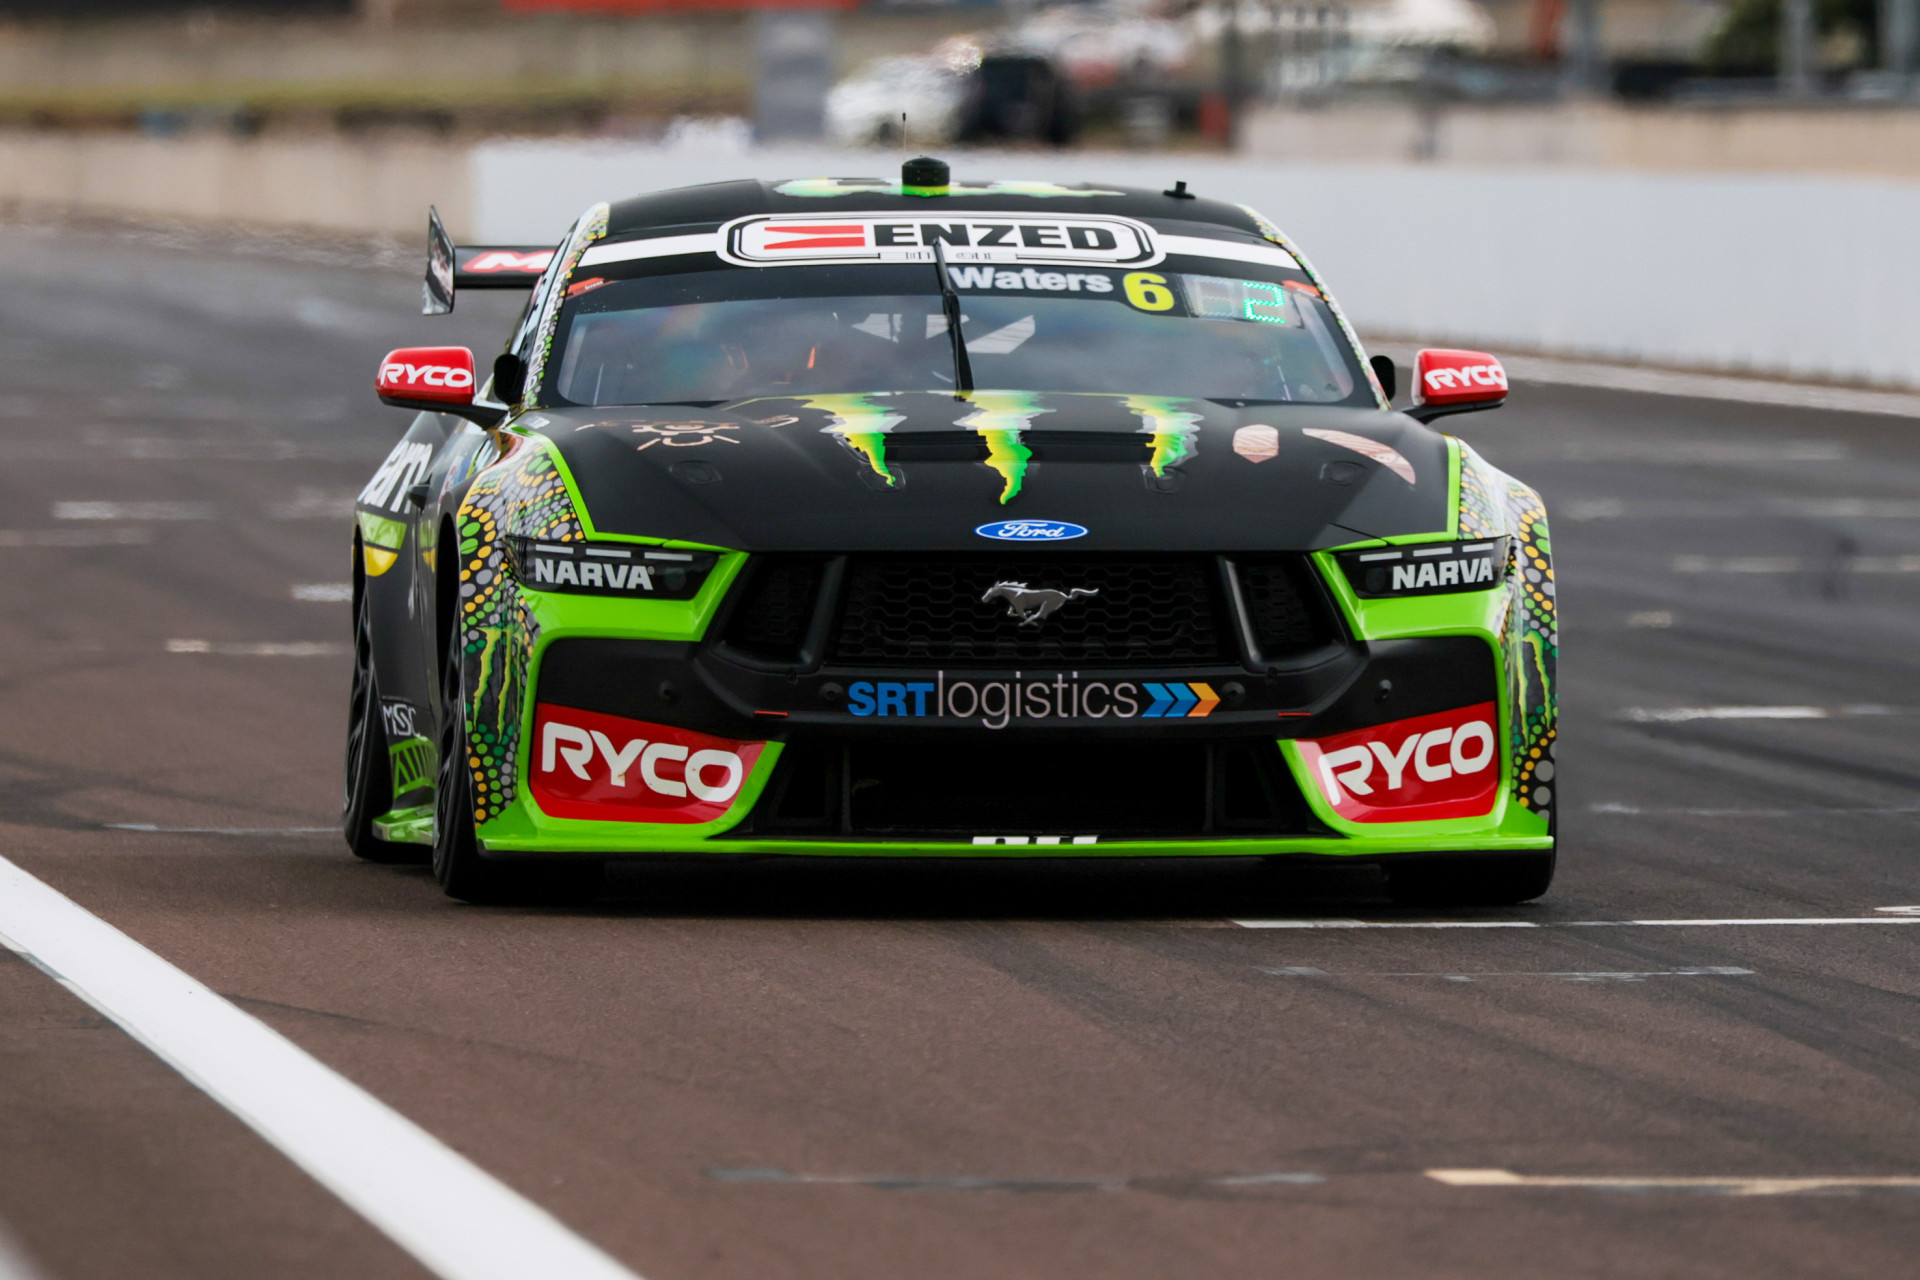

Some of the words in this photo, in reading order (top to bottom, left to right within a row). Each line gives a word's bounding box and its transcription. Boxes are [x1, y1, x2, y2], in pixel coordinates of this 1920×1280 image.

[874, 223, 1118, 250] ENZED
[947, 266, 1114, 293] Waters
[1123, 272, 1175, 311] 6
[1242, 280, 1286, 324] 2
[380, 363, 474, 388] RYCO
[1424, 364, 1508, 390] RYCO
[998, 522, 1065, 538] Ford
[535, 558, 654, 591] NARVA
[1392, 557, 1494, 591] NARVA
[542, 721, 744, 803] RYCO
[1318, 720, 1495, 805] RYCO
